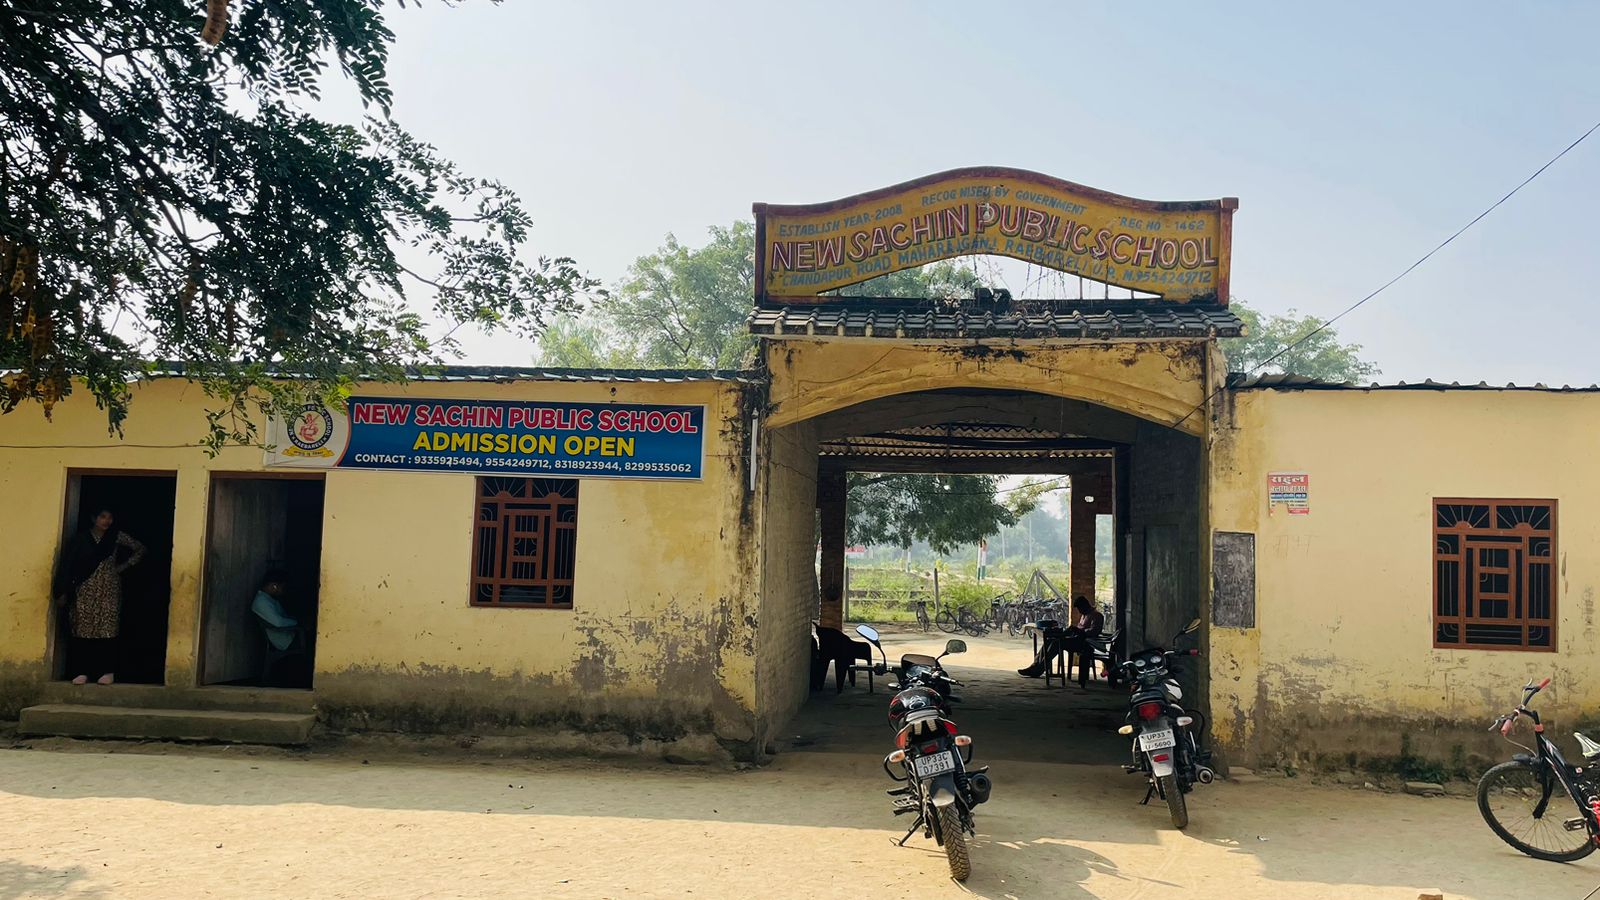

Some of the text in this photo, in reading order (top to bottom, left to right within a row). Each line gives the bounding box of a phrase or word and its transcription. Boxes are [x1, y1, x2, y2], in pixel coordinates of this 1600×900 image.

[995, 186, 1010, 198] BY
[1016, 190, 1087, 214] GOVERNMENT
[779, 218, 840, 237] ESTABLISH
[1120, 216, 1142, 229] REG
[1146, 221, 1161, 231] NO
[771, 201, 1218, 273] NEW SACHIN PUBLIC SCHOOL
[783, 268, 851, 286] CHANDAPUR
[857, 255, 892, 276] ROAD
[353, 403, 410, 425] NEW
[415, 405, 503, 428] SACHIN
[508, 407, 594, 431] PUBLIC
[597, 409, 698, 434] SCHOOL
[412, 431, 635, 457] ADMISSION OPEN
[354, 453, 406, 464] CONTACT
[485, 457, 552, 470] 9554249712,
[554, 460, 623, 472] 8318923944,
[624, 462, 692, 473] 8299535062
[1146, 732, 1166, 741] UP33
[921, 752, 948, 766] UP33C
